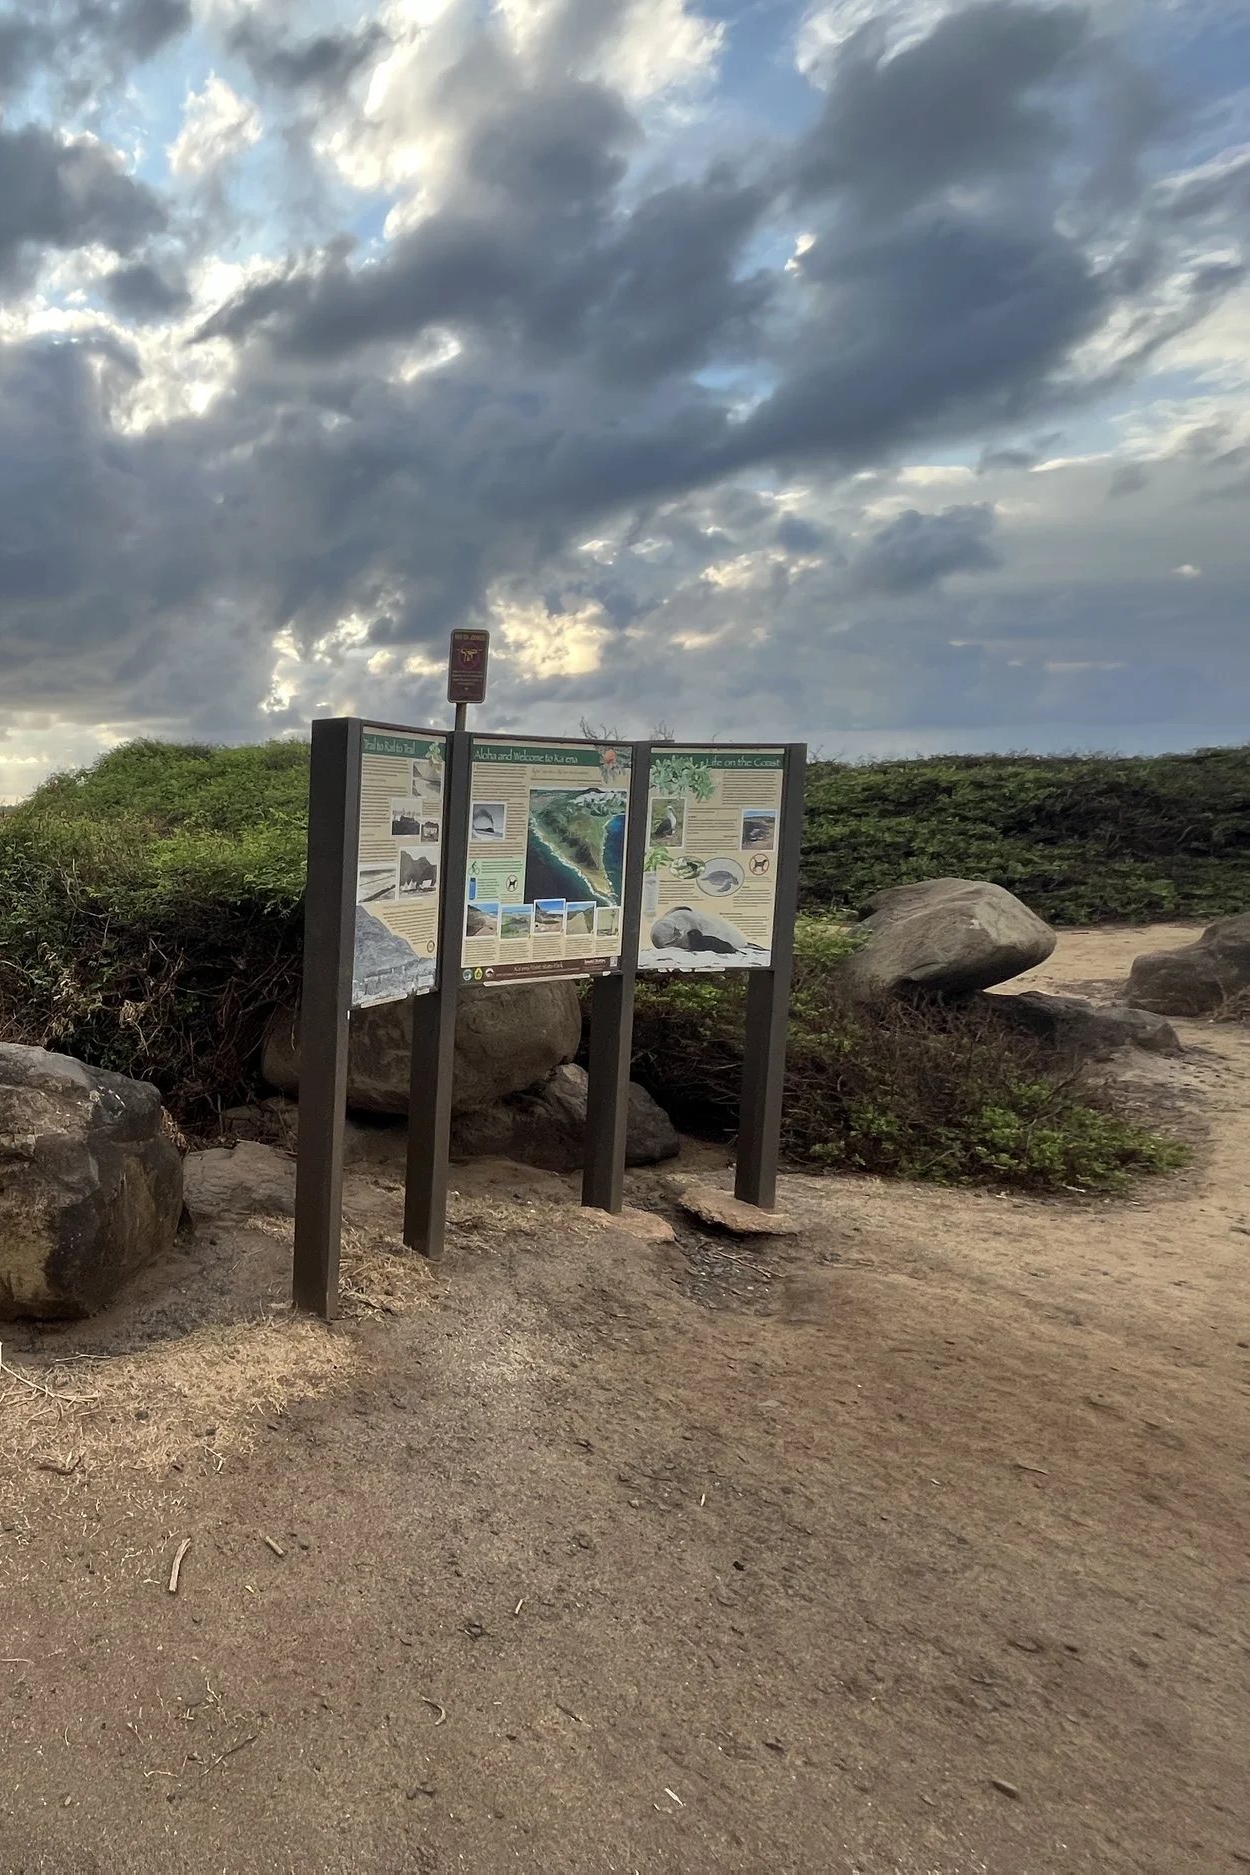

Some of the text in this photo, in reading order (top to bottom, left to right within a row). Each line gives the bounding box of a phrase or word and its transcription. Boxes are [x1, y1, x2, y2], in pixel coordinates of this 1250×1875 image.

[474, 748, 497, 761] Aloha
[497, 749, 513, 761] and
[513, 750, 545, 763] Welcome
[545, 753, 554, 763] to
[737, 755, 753, 767] the
[754, 758, 782, 767] Coast
